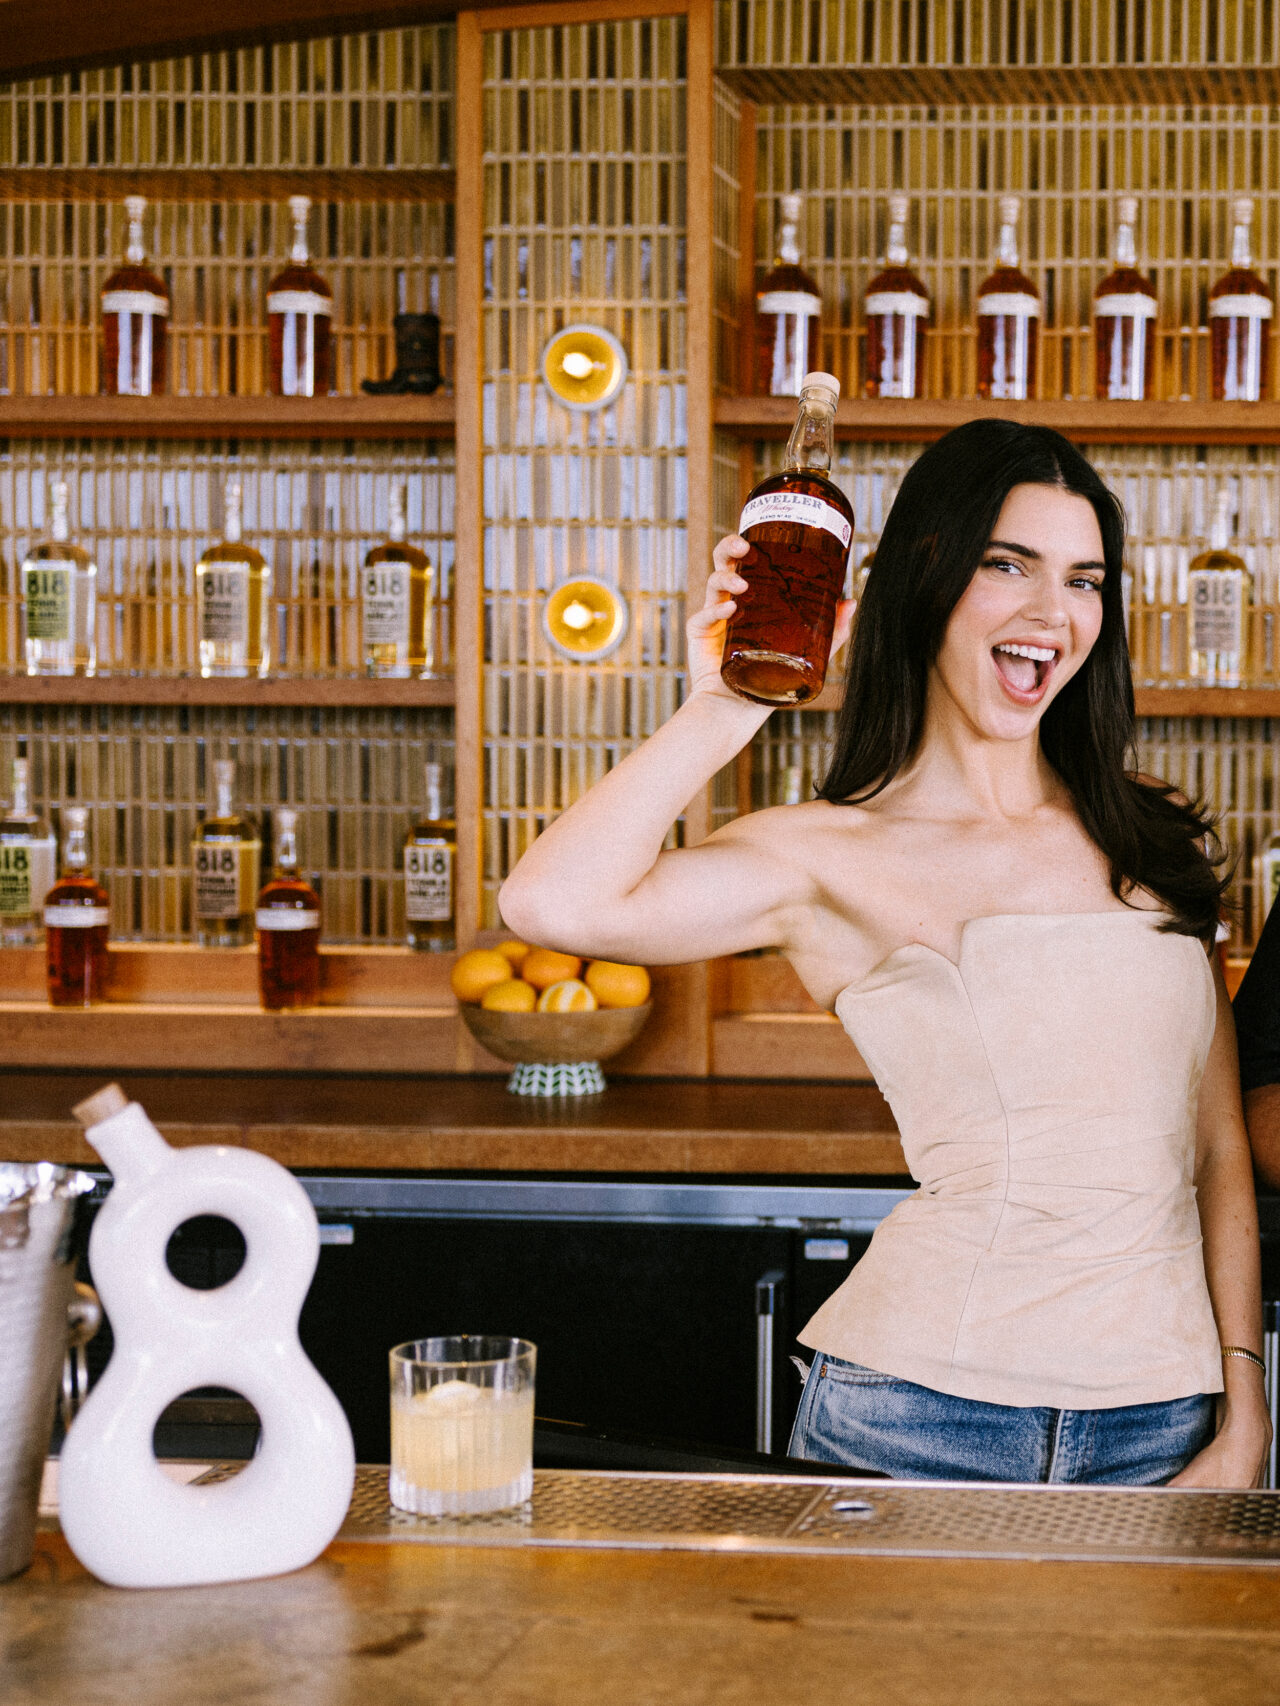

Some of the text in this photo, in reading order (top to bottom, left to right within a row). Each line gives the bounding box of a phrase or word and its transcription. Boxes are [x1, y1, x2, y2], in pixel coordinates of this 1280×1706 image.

[745, 495, 823, 514] TRAVELLER
[0, 847, 28, 871] 18
[196, 847, 235, 873] 818
[408, 850, 446, 875] 818
